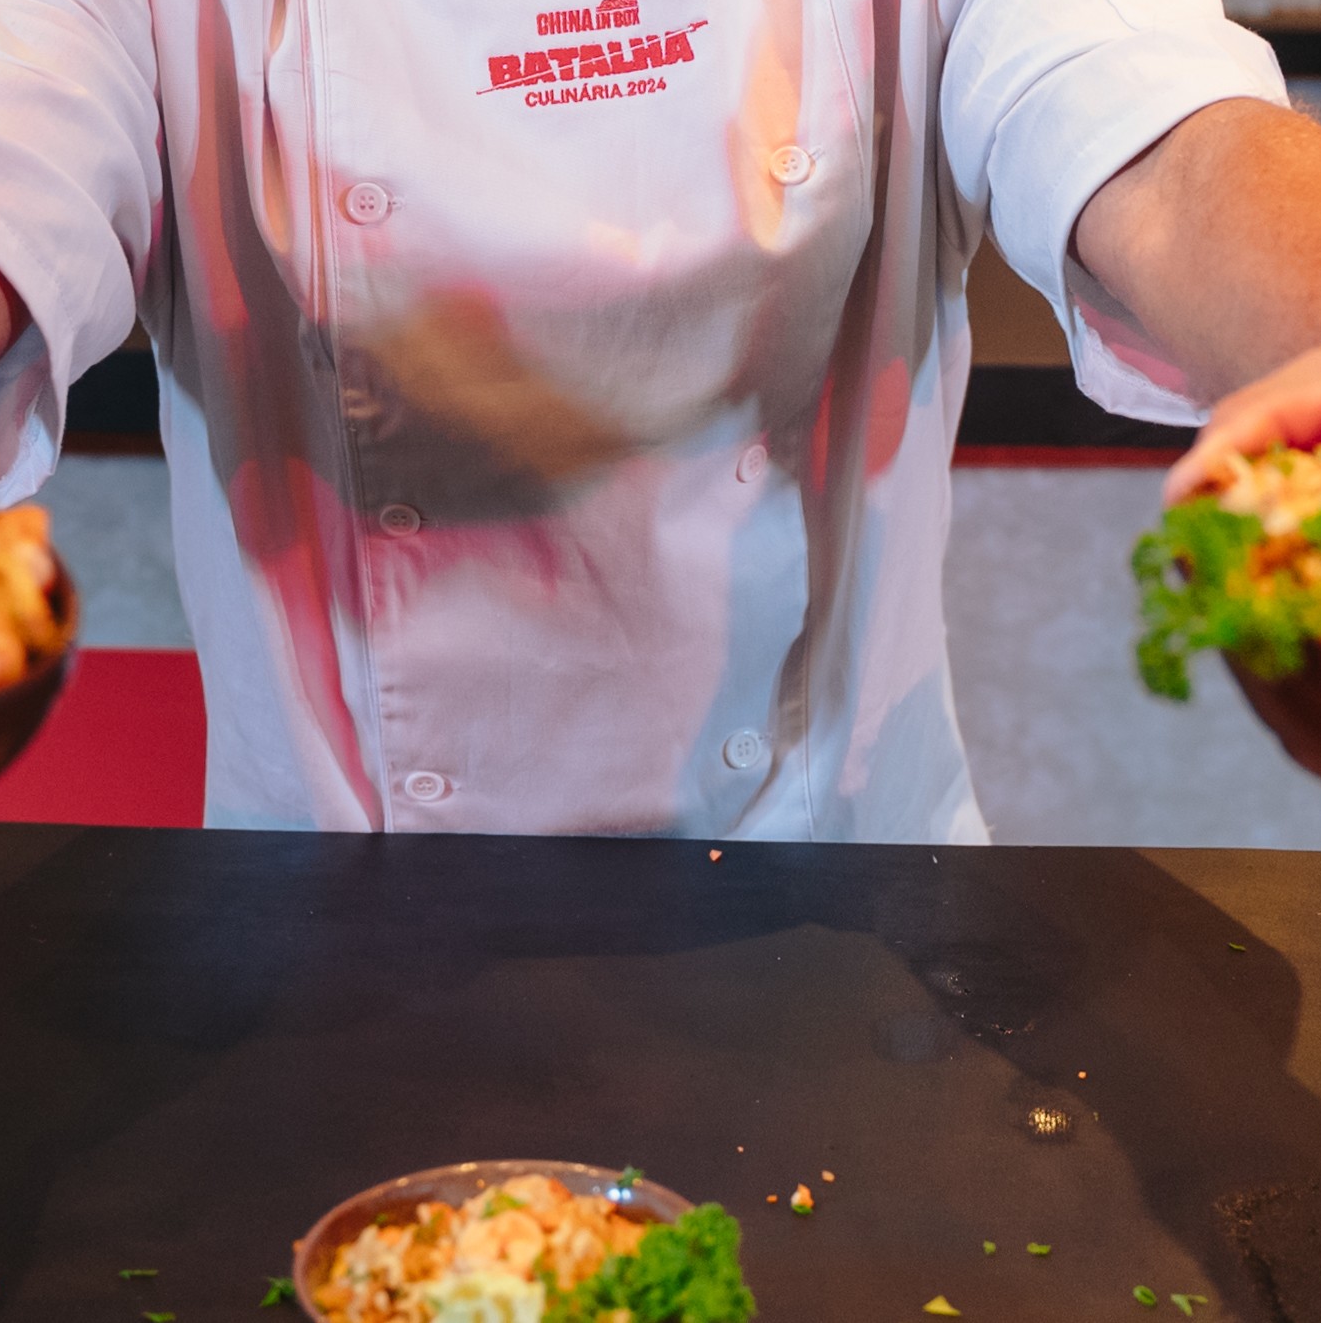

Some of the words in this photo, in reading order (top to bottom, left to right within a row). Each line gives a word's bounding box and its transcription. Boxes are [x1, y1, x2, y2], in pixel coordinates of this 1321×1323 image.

[595, 10, 611, 30] IN
[613, 6, 640, 28] BOX
[487, 30, 695, 90] BATALHA
[524, 83, 623, 107] CULINÁRIA
[627, 78, 667, 97] 2024
